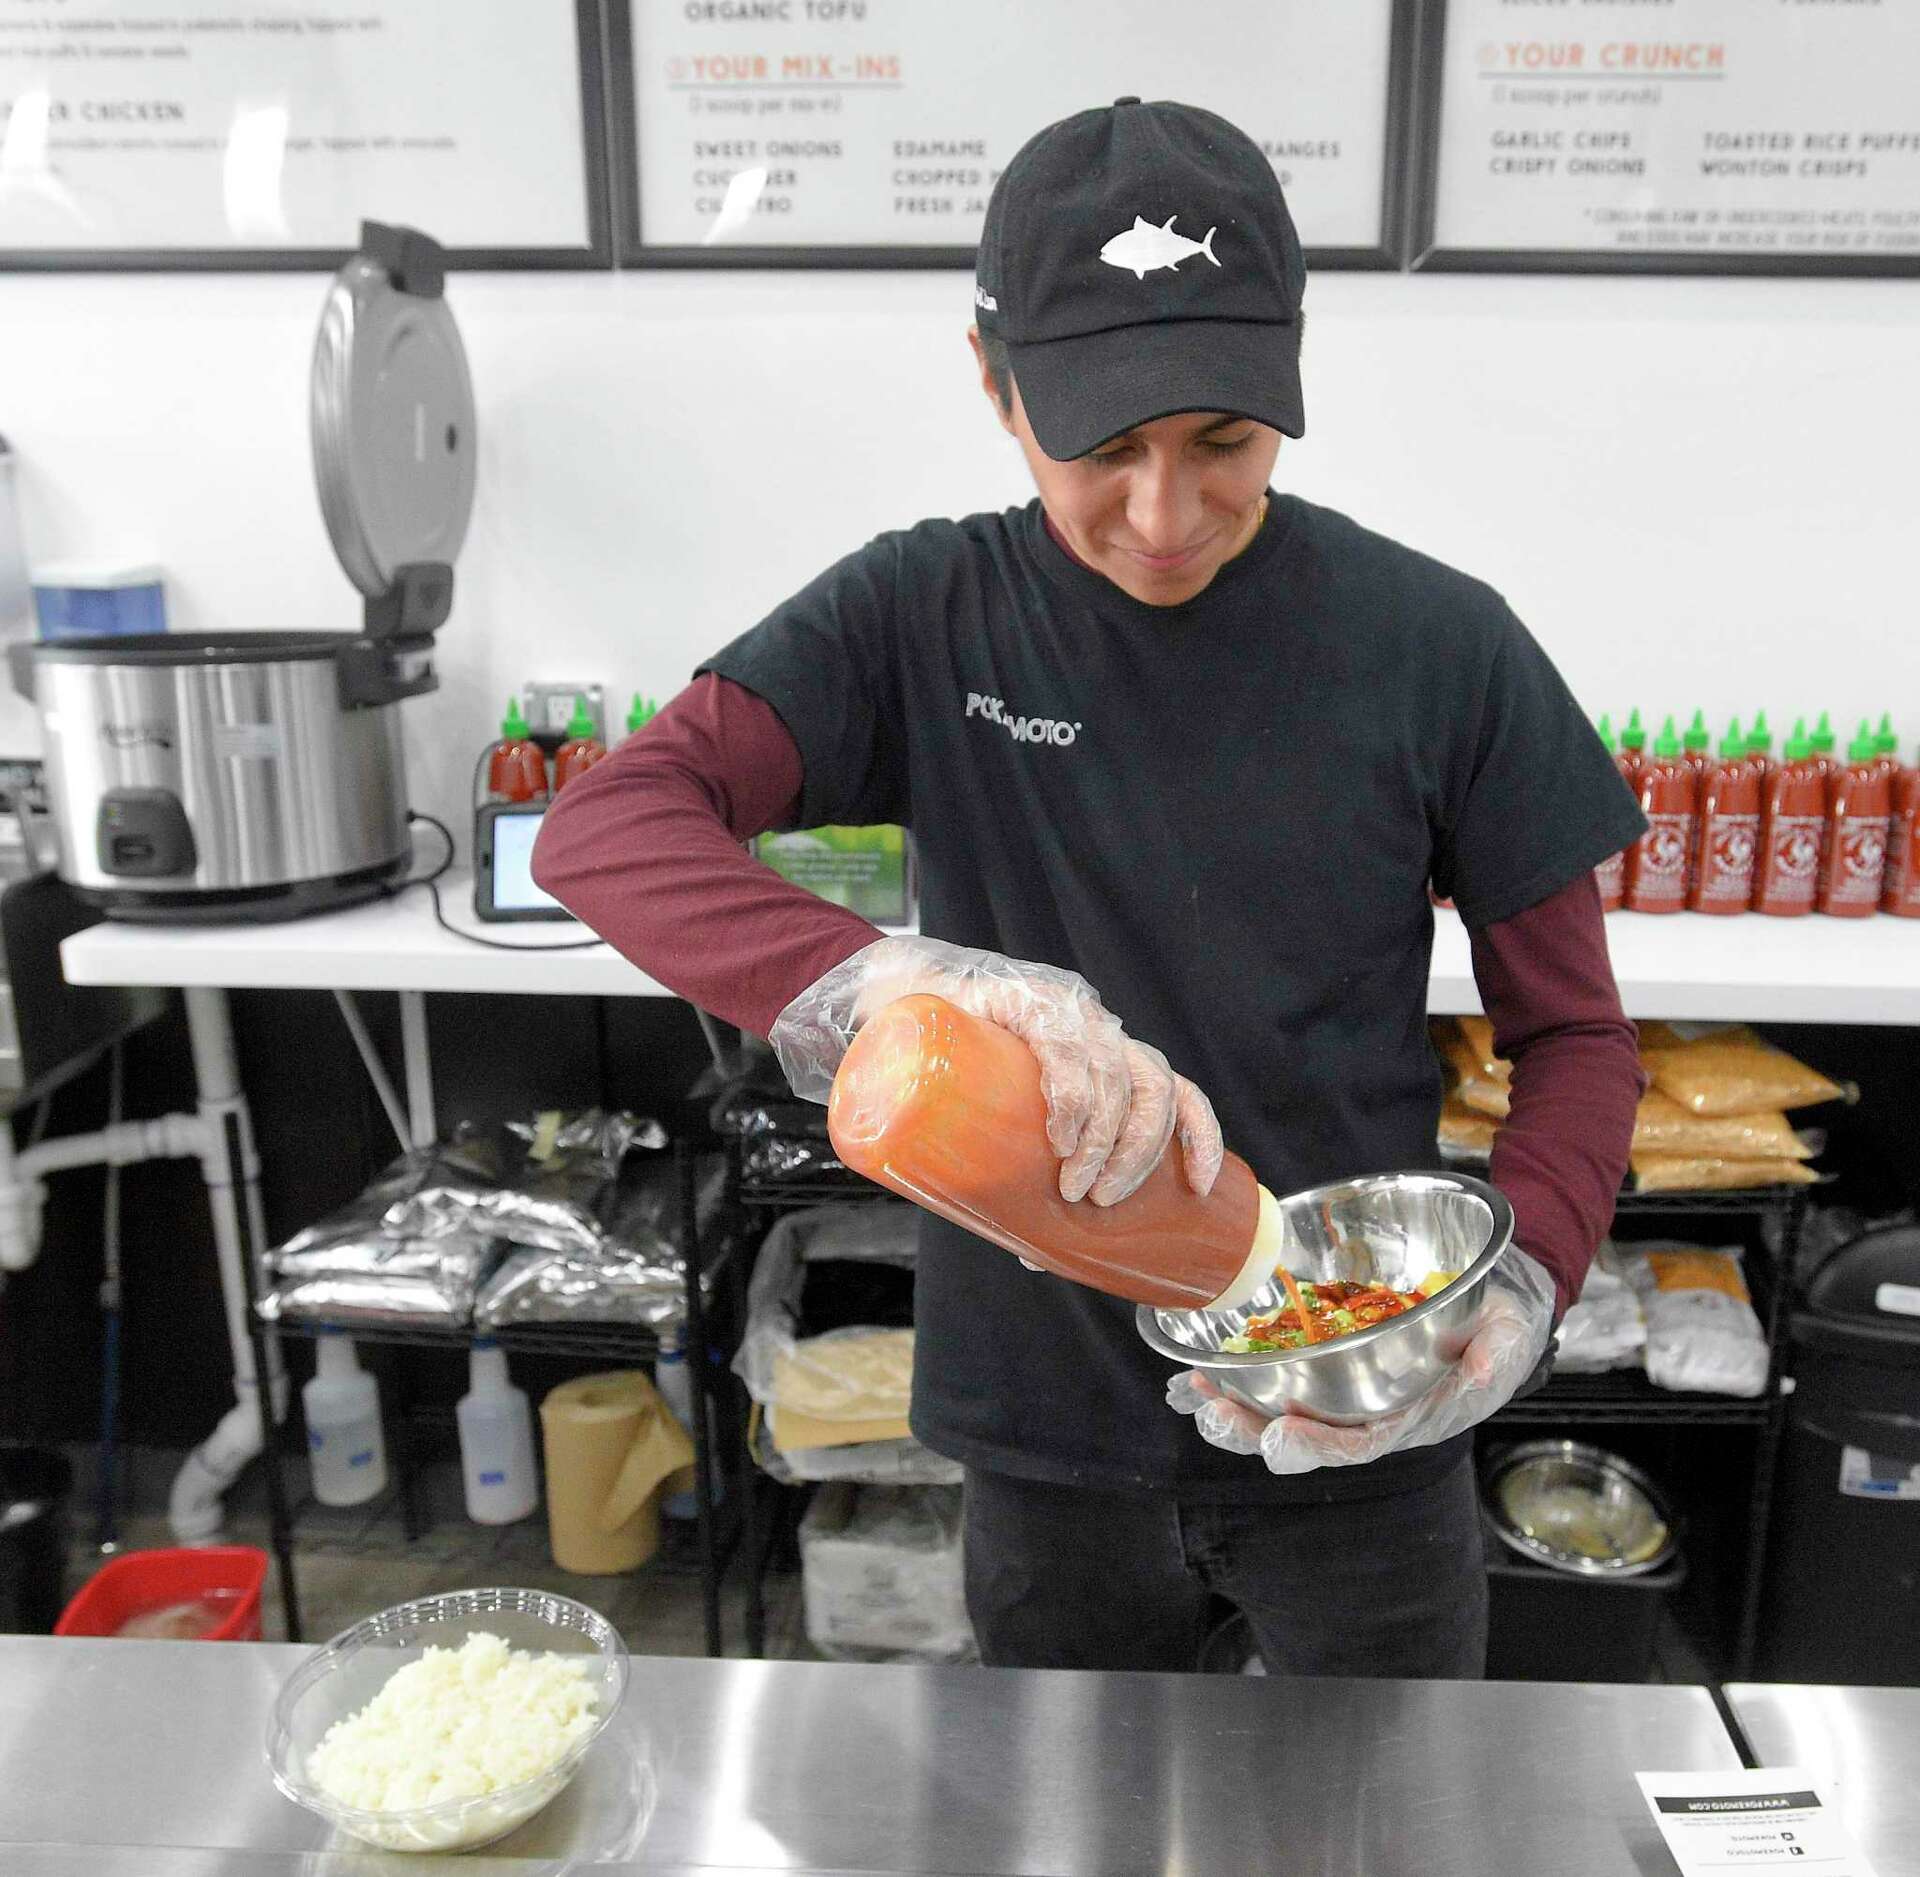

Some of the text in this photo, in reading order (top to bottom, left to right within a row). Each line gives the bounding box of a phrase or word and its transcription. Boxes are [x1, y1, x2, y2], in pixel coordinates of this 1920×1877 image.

[684, 0, 867, 21] ORGANIC TOFU
[1505, 42, 1584, 67] YOUR
[1601, 43, 1725, 68] CRUNCH
[691, 56, 768, 80] YOUR
[781, 56, 901, 79] MIX-INS
[80, 101, 185, 122] CHICKEN
[694, 140, 844, 159] SWEET ONIONS
[893, 140, 986, 158] EDAMAME
[1262, 140, 1340, 159] RANGES
[1490, 131, 1631, 150] GARLIC CHIPS
[1703, 132, 1794, 152] TOASTED
[1803, 132, 1850, 152] RICE
[1489, 157, 1647, 176] CRISPY ONIONS
[1699, 158, 1868, 177] WONTON CRISPS
[892, 168, 980, 187] CHOPPED
[894, 197, 951, 214] FRESH
